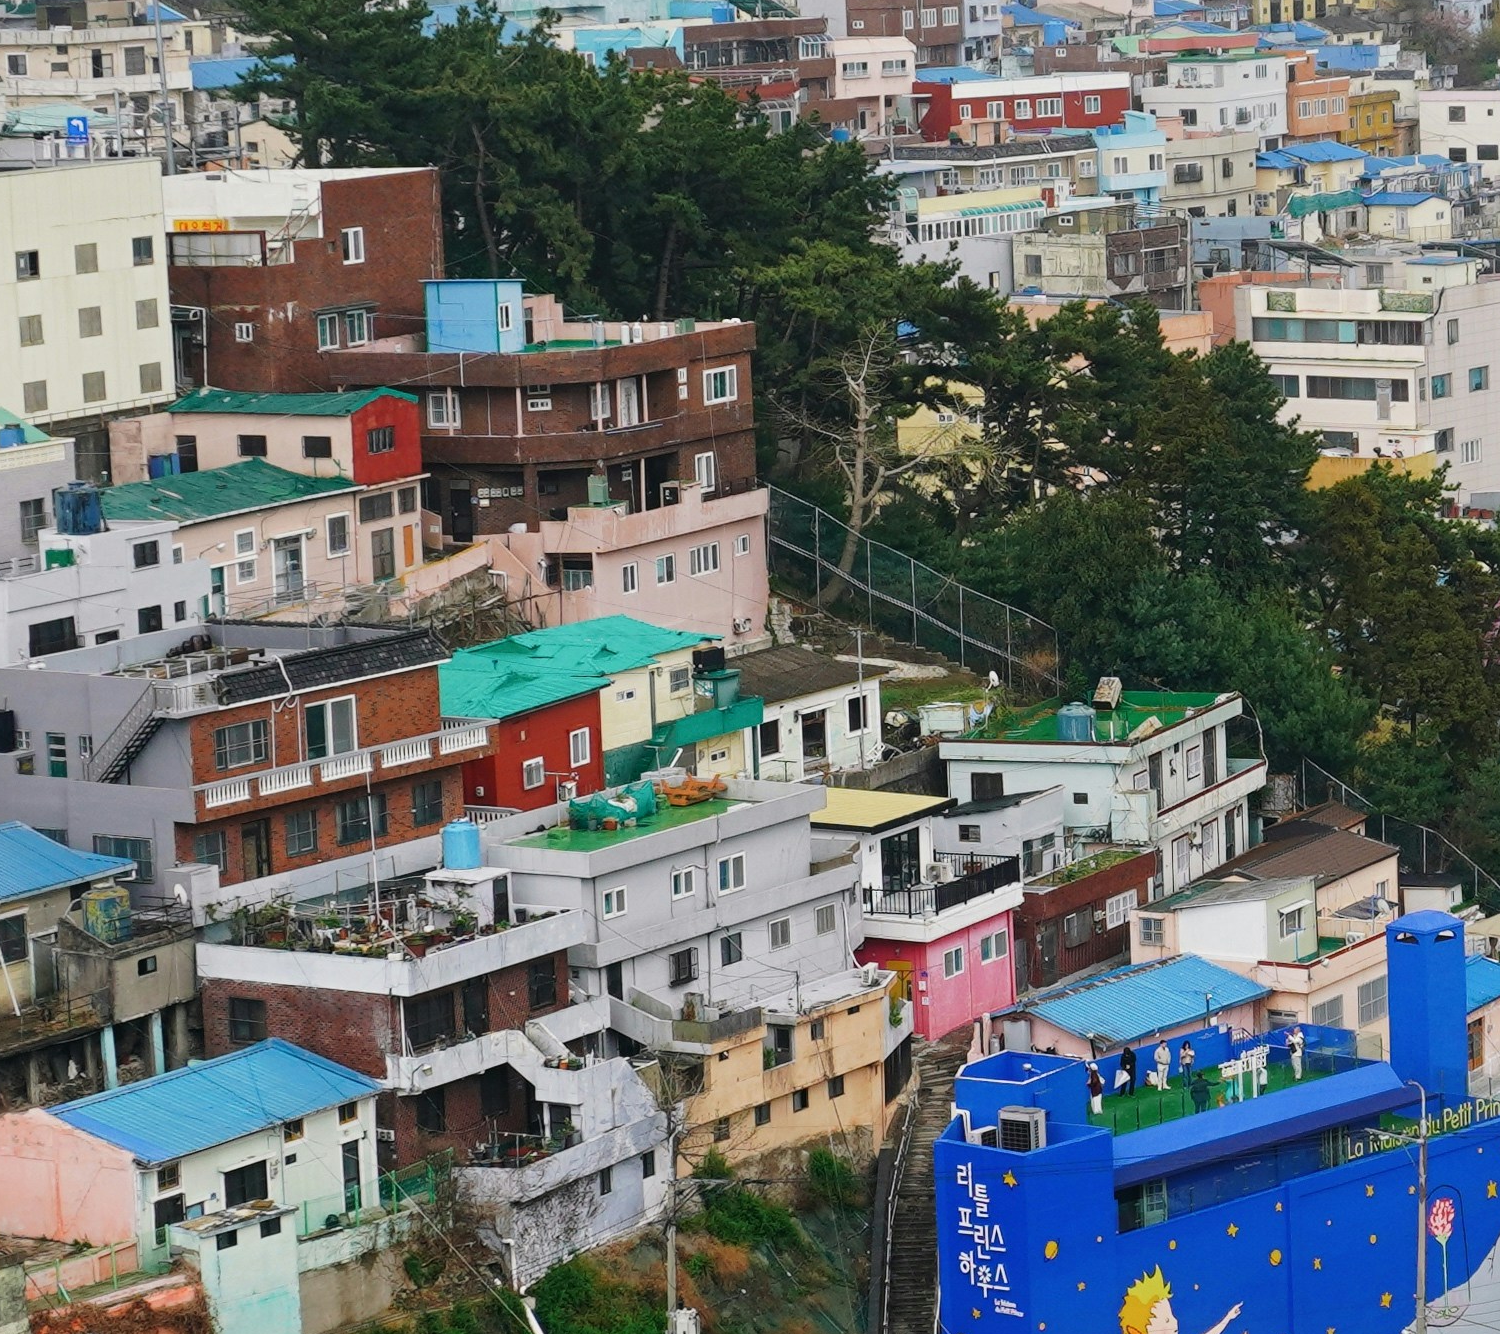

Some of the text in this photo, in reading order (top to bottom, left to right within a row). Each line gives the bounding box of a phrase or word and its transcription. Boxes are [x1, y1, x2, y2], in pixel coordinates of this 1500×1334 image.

[1347, 1136, 1364, 1160] La
[1443, 1101, 1472, 1133] Petit
[957, 1162, 990, 1217] 리틀
[958, 1208, 1006, 1260] 프린스
[958, 1251, 1010, 1298] 하우스
